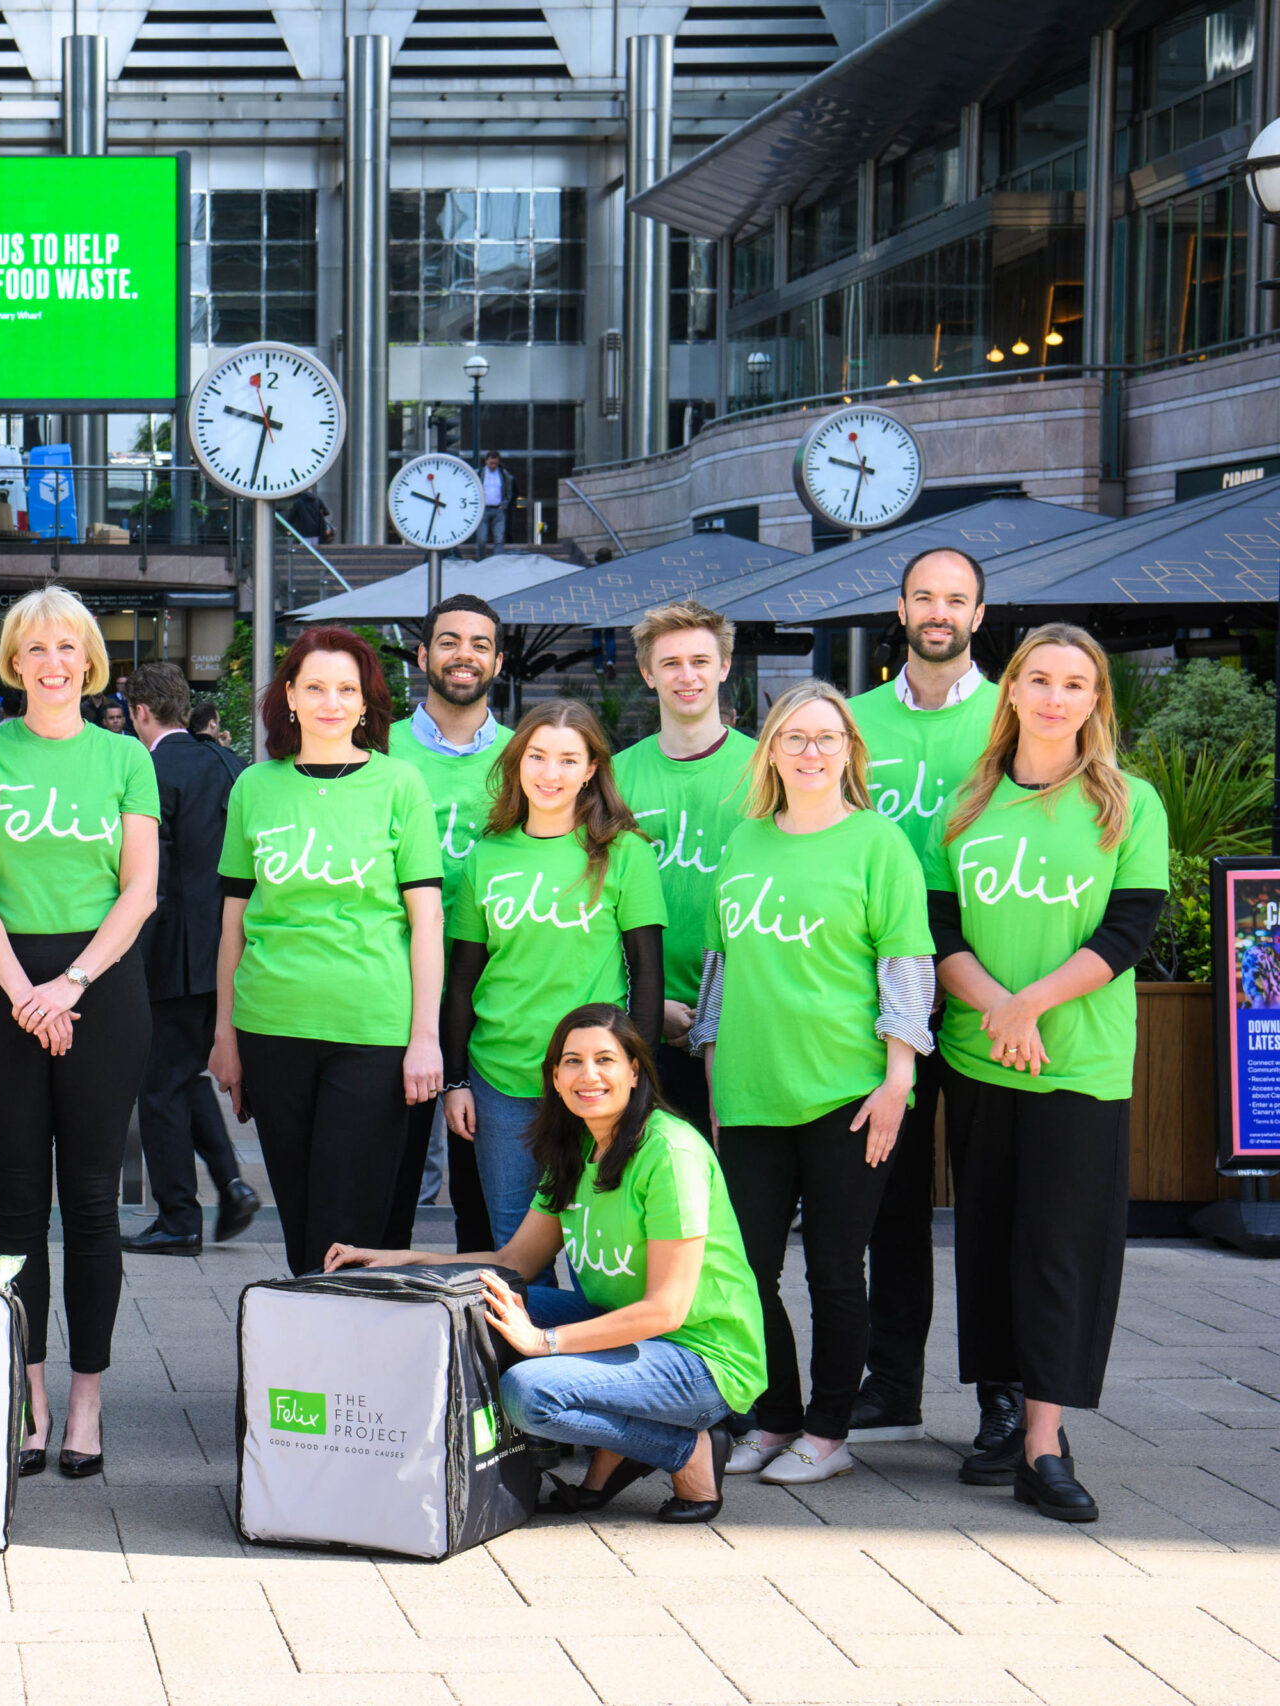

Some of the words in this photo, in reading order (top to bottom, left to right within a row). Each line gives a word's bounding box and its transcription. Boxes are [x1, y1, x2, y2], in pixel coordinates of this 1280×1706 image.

[30, 233, 58, 265] TO
[64, 233, 119, 265] HELP
[55, 268, 138, 300] WASTE.
[16, 311, 42, 320] Wharf
[459, 497, 467, 510] 3
[253, 824, 376, 889] Felix
[957, 834, 1095, 909] Felix
[481, 871, 603, 934] Felix
[719, 872, 825, 949] Felix
[275, 1395, 320, 1428] Felix
[334, 1393, 367, 1408] THE
[334, 1408, 384, 1425] FELIX
[269, 1438, 291, 1448] GOOD
[295, 1442, 319, 1451] FOOD
[324, 1444, 339, 1452] FOR
[345, 1446, 370, 1456] GOOD
[374, 1449, 405, 1459] CAUSES
[334, 1424, 408, 1443] PROJECT
